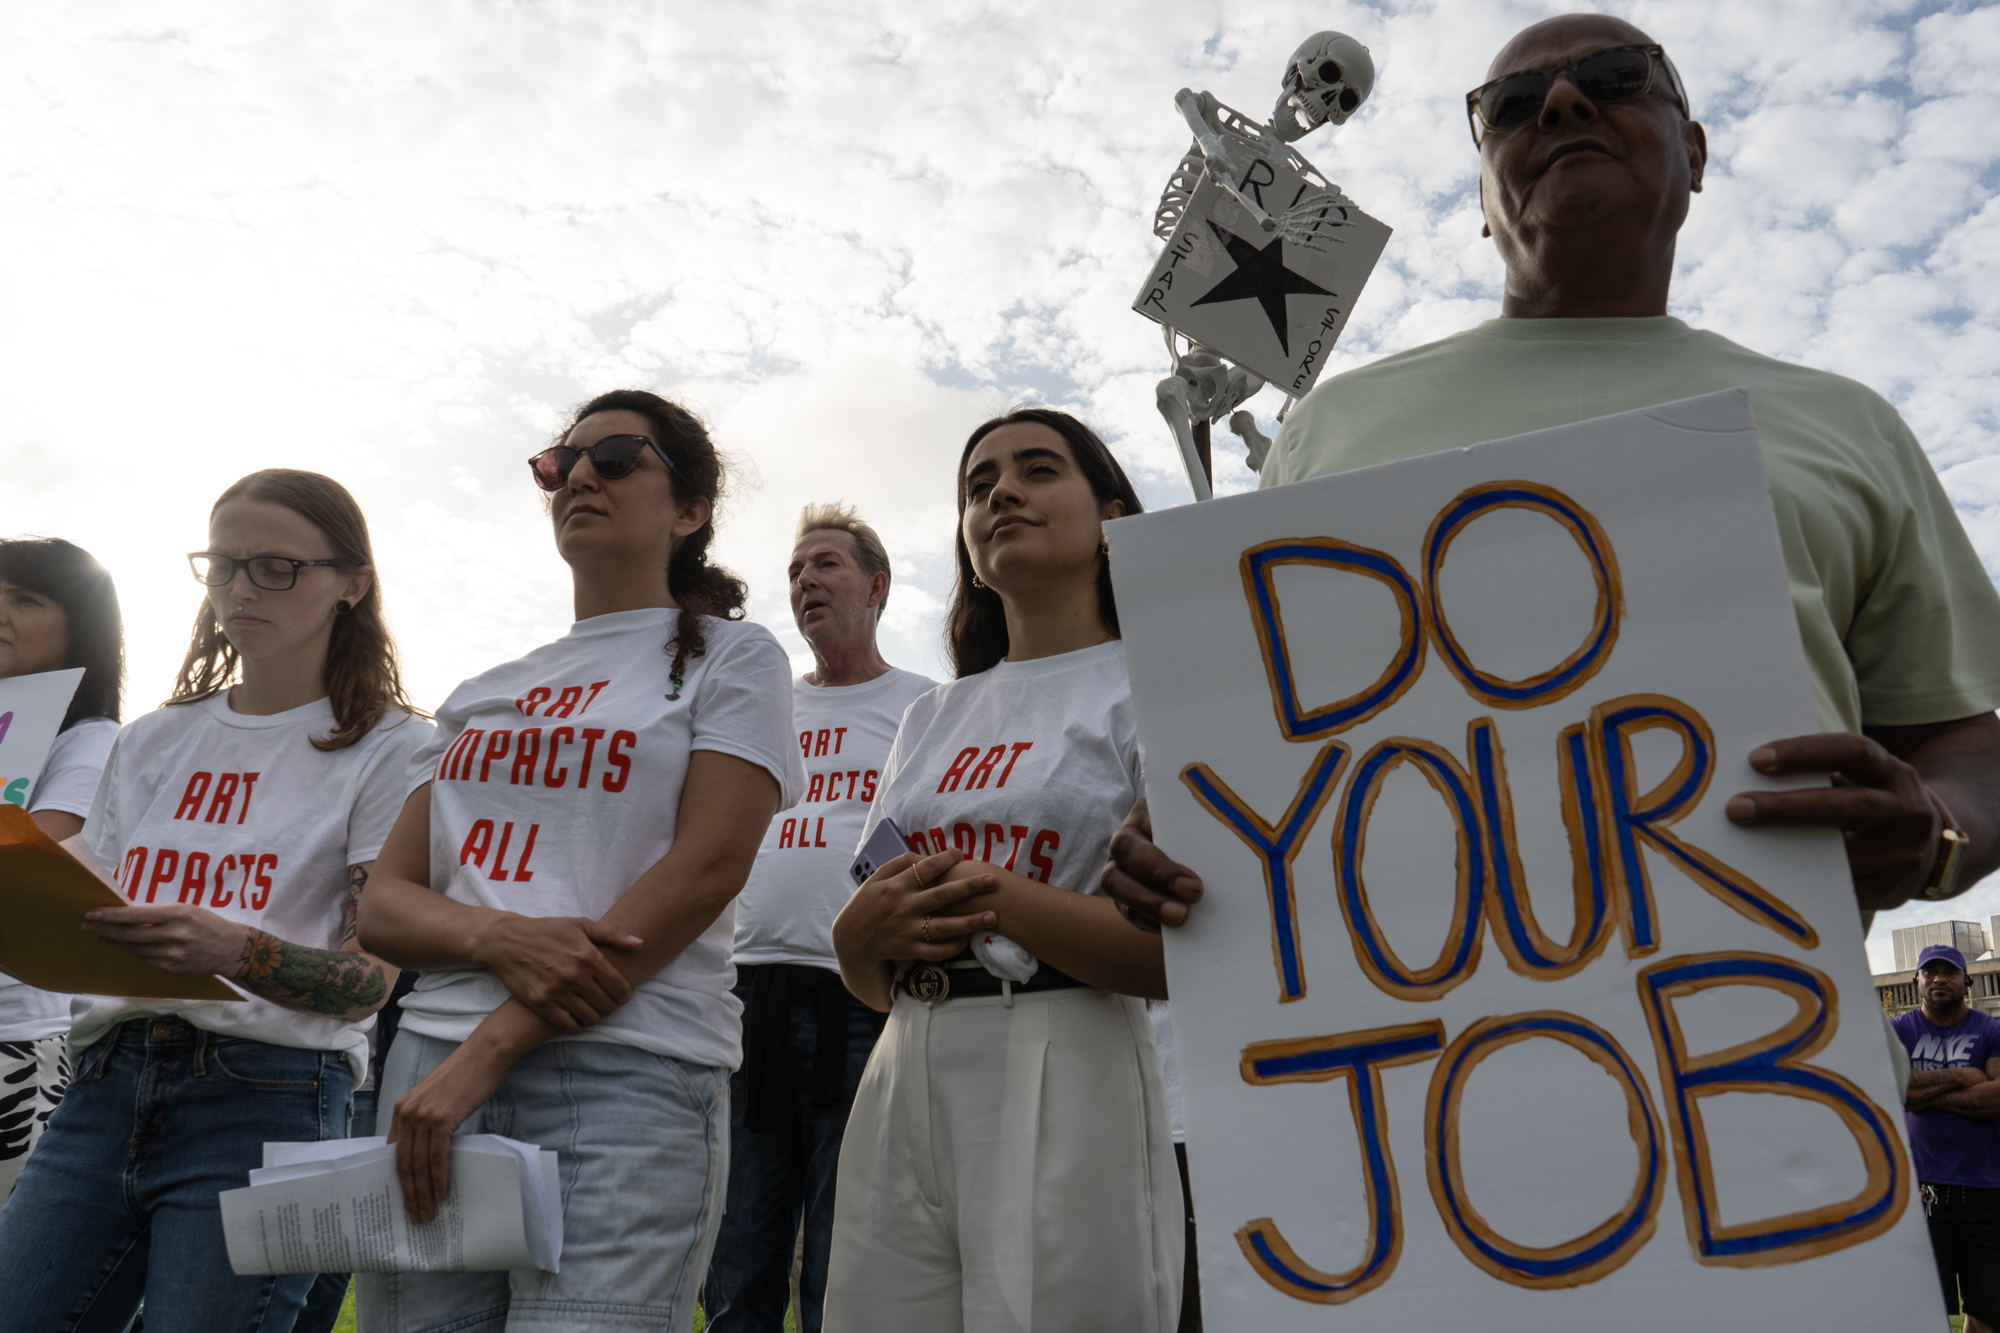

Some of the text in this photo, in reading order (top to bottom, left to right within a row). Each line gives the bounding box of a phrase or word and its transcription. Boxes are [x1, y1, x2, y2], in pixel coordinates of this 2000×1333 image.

[1143, 231, 1199, 313] STAR
[1292, 307, 1341, 390] STORE
[1239, 480, 1628, 744] DO
[798, 727, 847, 758] ART
[935, 741, 1034, 794] ART
[173, 771, 260, 825] ART
[806, 769, 878, 803] ACTS
[460, 818, 540, 882] ALL
[779, 817, 827, 849] ALL
[1178, 692, 1820, 1004] YOUR
[1911, 1033, 1980, 1062] NIKE
[1232, 951, 1912, 1306] JOB
